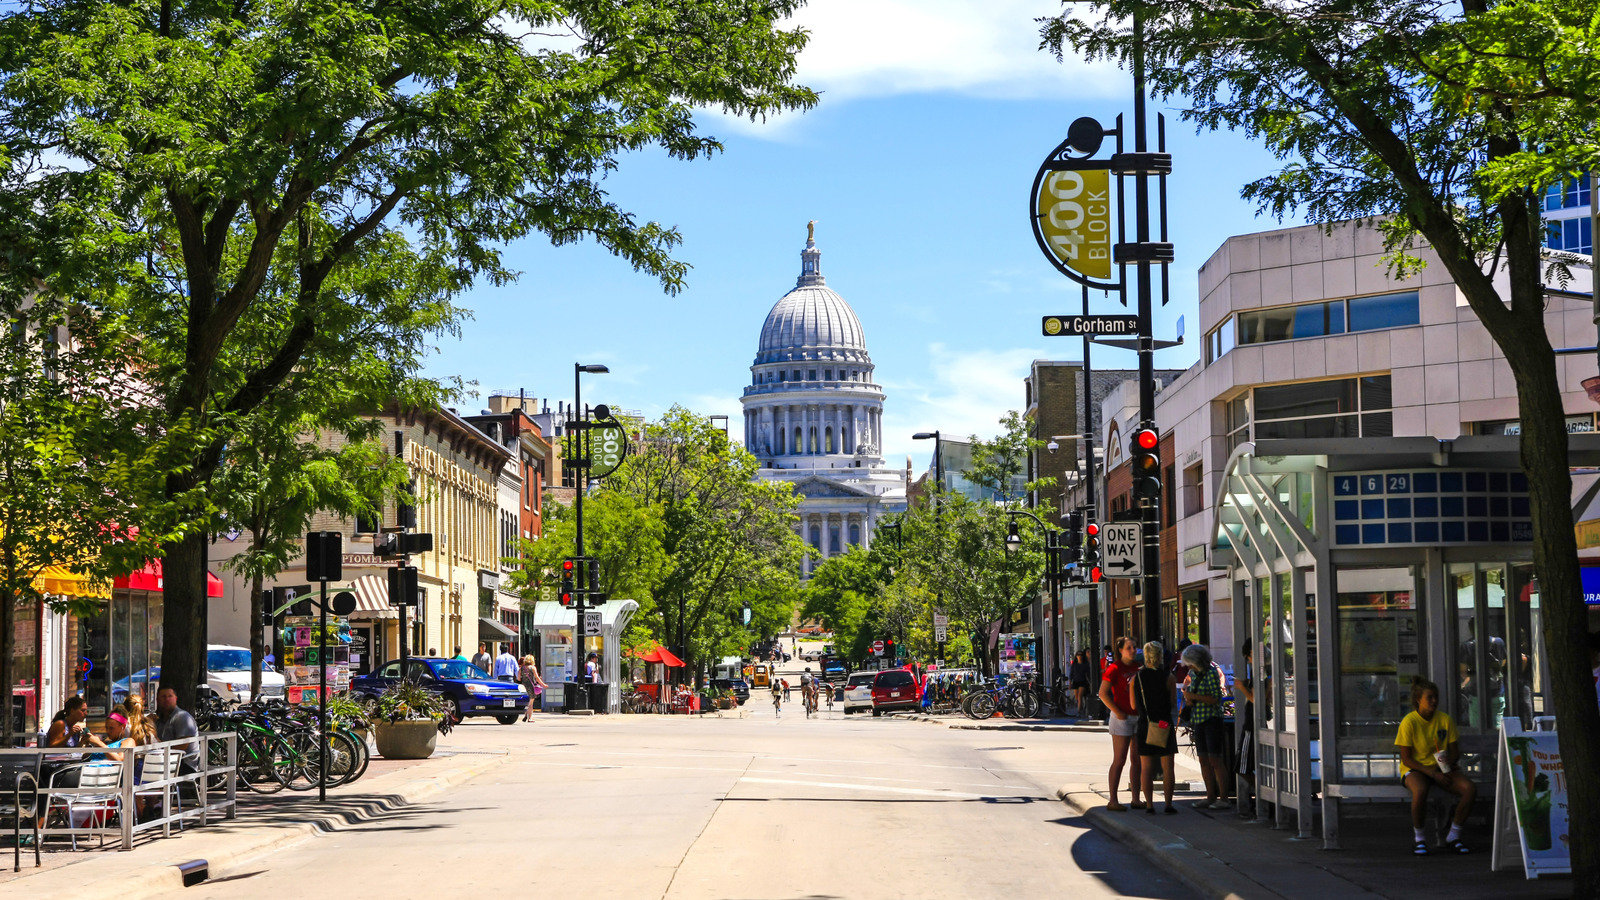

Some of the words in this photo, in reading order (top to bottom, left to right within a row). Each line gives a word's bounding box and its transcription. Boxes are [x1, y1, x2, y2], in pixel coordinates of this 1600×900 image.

[1048, 170, 1085, 260] 400
[1087, 190, 1107, 260] BLOCK
[1063, 321, 1070, 329] W
[1073, 317, 1125, 333] Gorham
[1128, 320, 1137, 329] St
[1566, 421, 1589, 433] ARDS
[593, 435, 603, 466] BLOCK
[602, 428, 619, 467] 300
[1341, 479, 1350, 492] 4
[1368, 477, 1376, 491] 6
[1390, 477, 1406, 490] 29
[1107, 528, 1136, 541] ONE
[1107, 543, 1136, 556] WAY
[541, 586, 551, 601] 00
[1583, 593, 1600, 602] URA
[937, 633, 945, 641] 15
[1532, 749, 1548, 760] YOU
[1540, 762, 1565, 771] WHA
